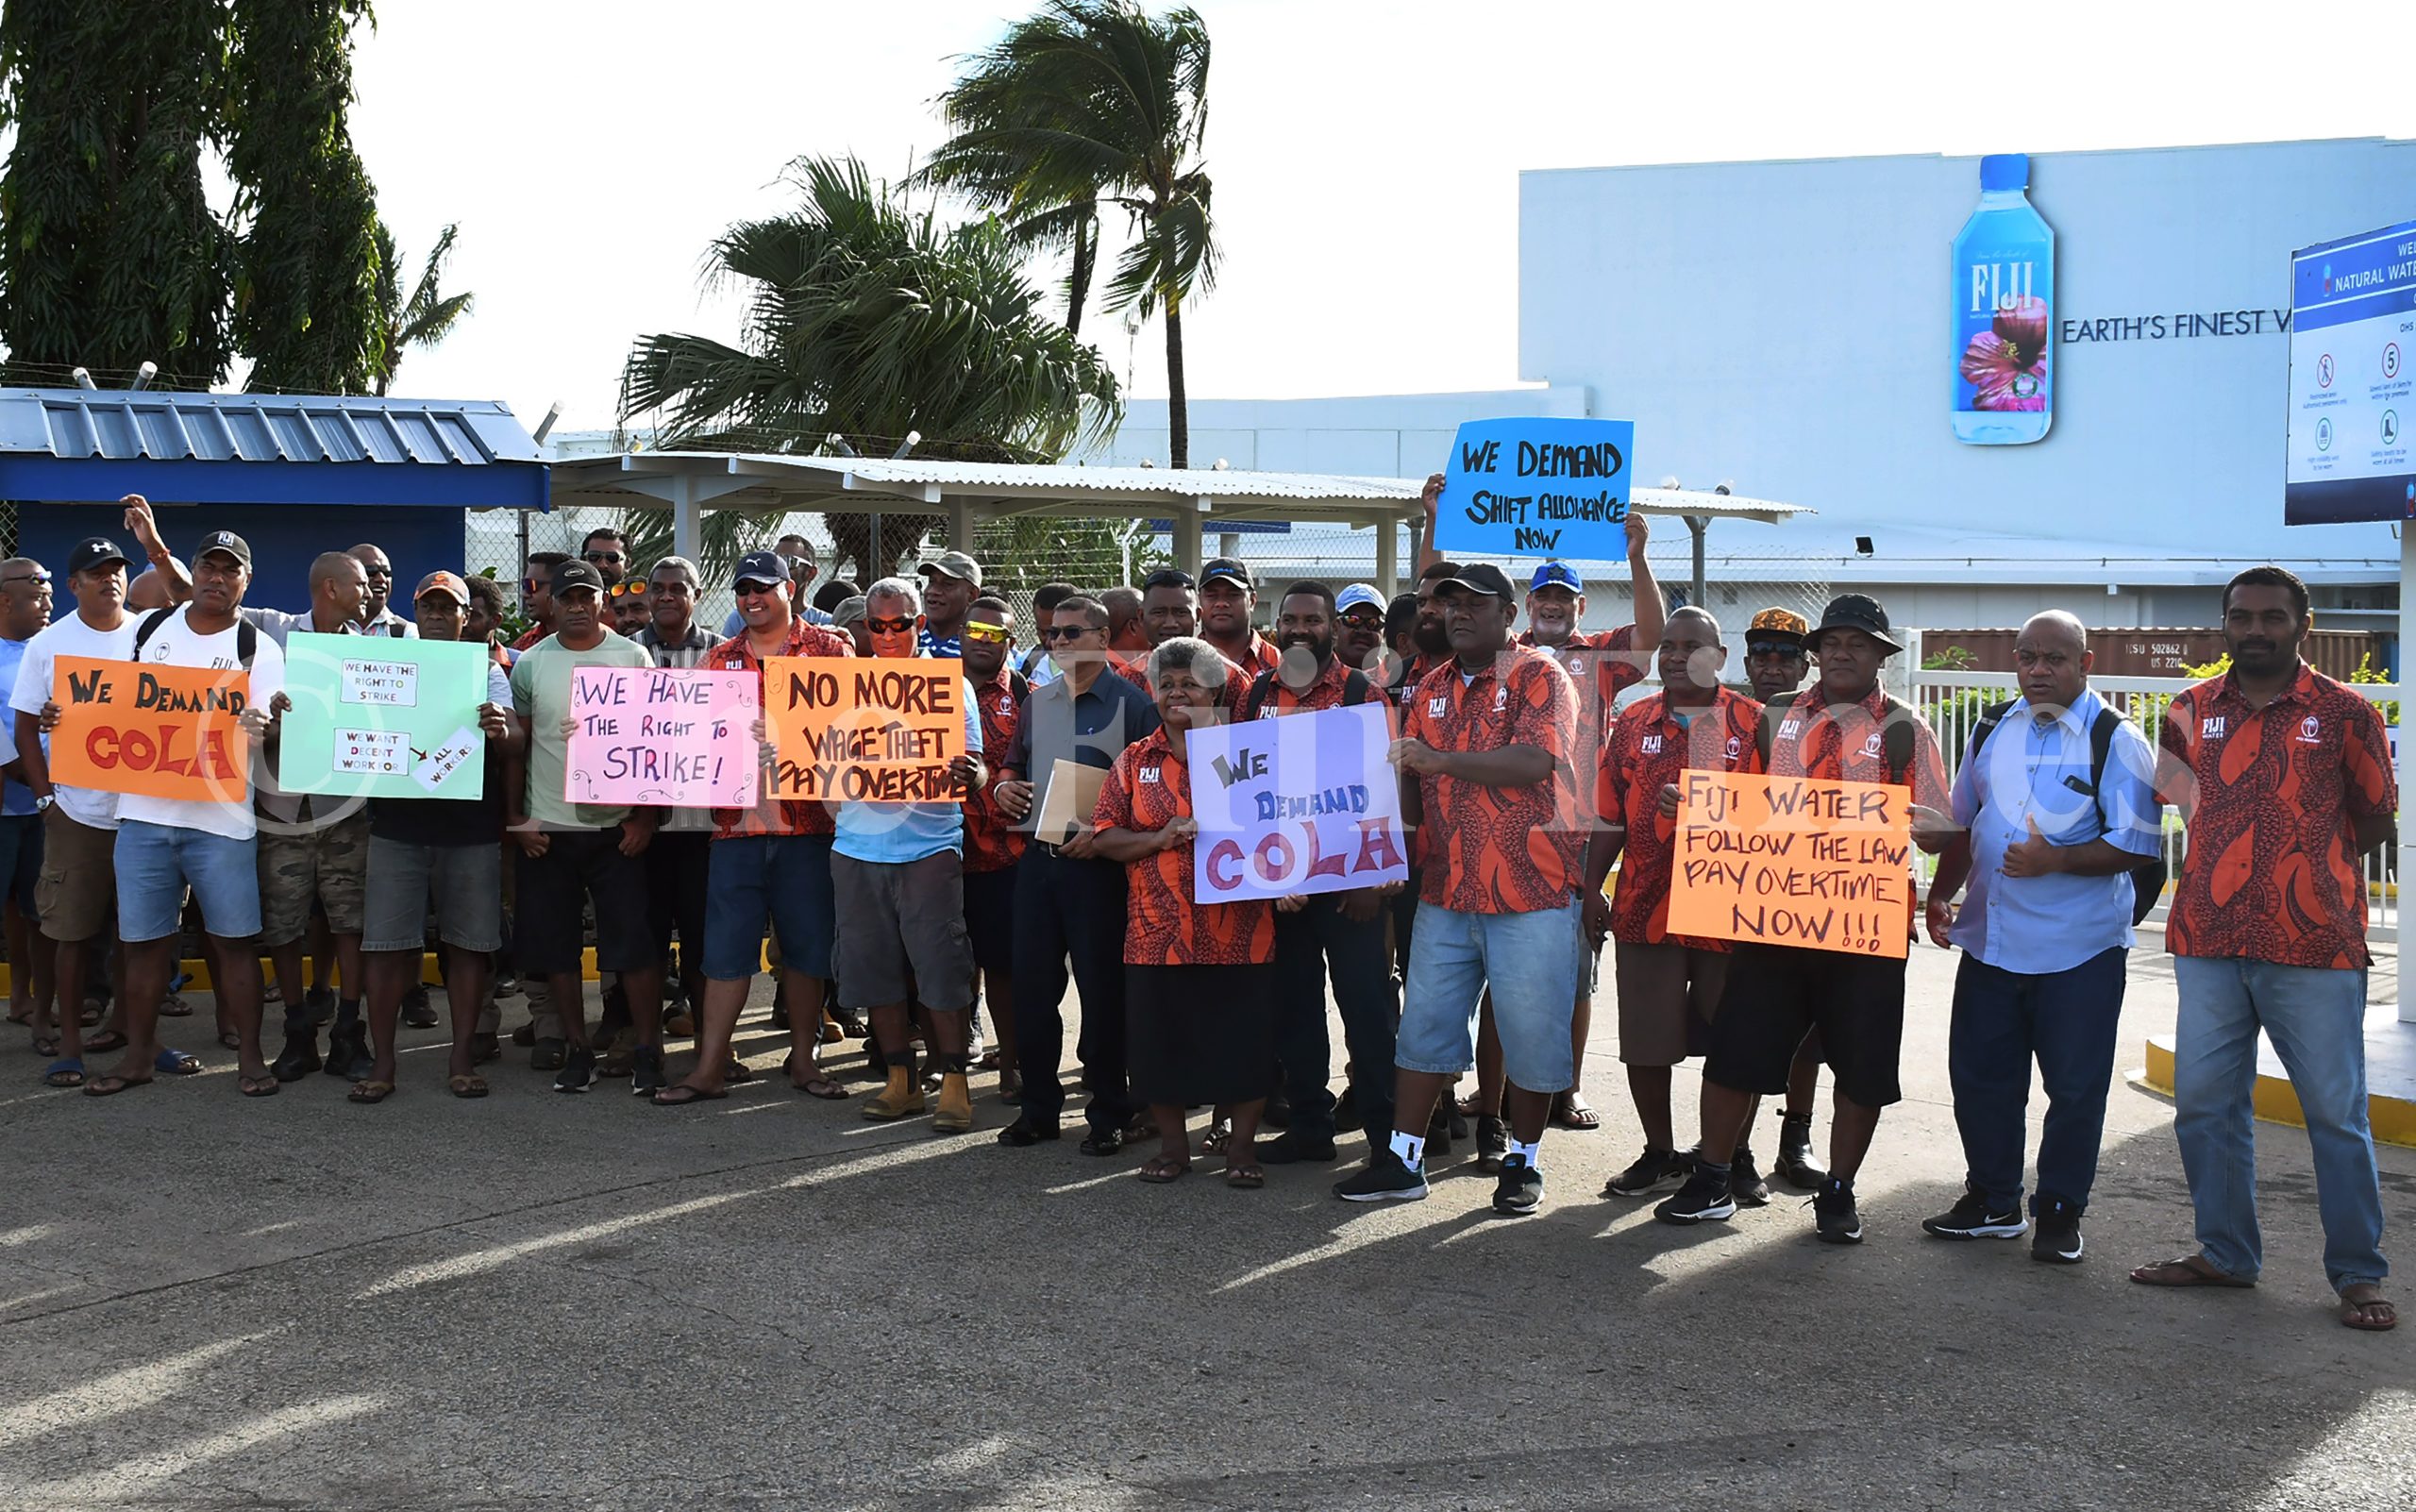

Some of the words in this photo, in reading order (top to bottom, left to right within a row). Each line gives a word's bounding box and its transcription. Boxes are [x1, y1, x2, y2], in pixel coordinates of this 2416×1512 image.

[1971, 261, 2033, 311] FIJI
[2335, 267, 2385, 293] NATURAL
[2062, 315, 2166, 344] EARTH'S
[2174, 311, 2265, 338] FINEST
[2400, 322, 2414, 332] OHS
[2387, 350, 2395, 370] 5
[1463, 440, 1501, 473] WE
[1518, 441, 1622, 479] DEMAND
[1466, 490, 1533, 525] SHIFT
[1537, 491, 1626, 524] ALLOWANCE
[1514, 527, 1562, 550] NOW
[355, 678, 386, 687] RIGHT
[390, 680, 404, 689] TO
[363, 664, 393, 674] HAVE
[394, 666, 415, 676] THE
[68, 670, 113, 705] WE
[135, 672, 245, 715] DEMAND
[360, 691, 397, 702] STRIKE
[580, 673, 628, 705] WE
[647, 673, 713, 705] HAVE
[788, 670, 839, 712] NO
[854, 671, 954, 715] MORE
[346, 732, 363, 742] WE
[365, 733, 398, 744] WANT
[584, 714, 619, 736] THE
[641, 714, 696, 737] RIGHT
[712, 720, 728, 739] TO
[1778, 720, 1800, 733] FIJI
[2203, 717, 2224, 733] FIJI
[86, 725, 237, 780] COLA
[351, 747, 394, 757] DECENT
[433, 747, 452, 764] ALL
[802, 725, 881, 762] WAGE
[877, 721, 949, 759] THEFT
[1642, 735, 1662, 749] FIJI
[343, 760, 376, 769] WORK
[378, 762, 398, 771] FOR
[430, 744, 473, 784] WORKERS
[766, 759, 838, 799] PAY
[1211, 748, 1268, 789] WE
[1253, 784, 1369, 822] DEMAND
[1687, 775, 1738, 822] FIJI
[1763, 781, 1889, 824] WATER
[1206, 815, 1405, 891] COLA
[1686, 825, 1795, 856] FOLLOW
[1806, 832, 1852, 863] THE
[1858, 837, 1908, 865] LAW
[1684, 859, 1750, 894] PAY
[1755, 865, 1902, 904] OVERTIME
